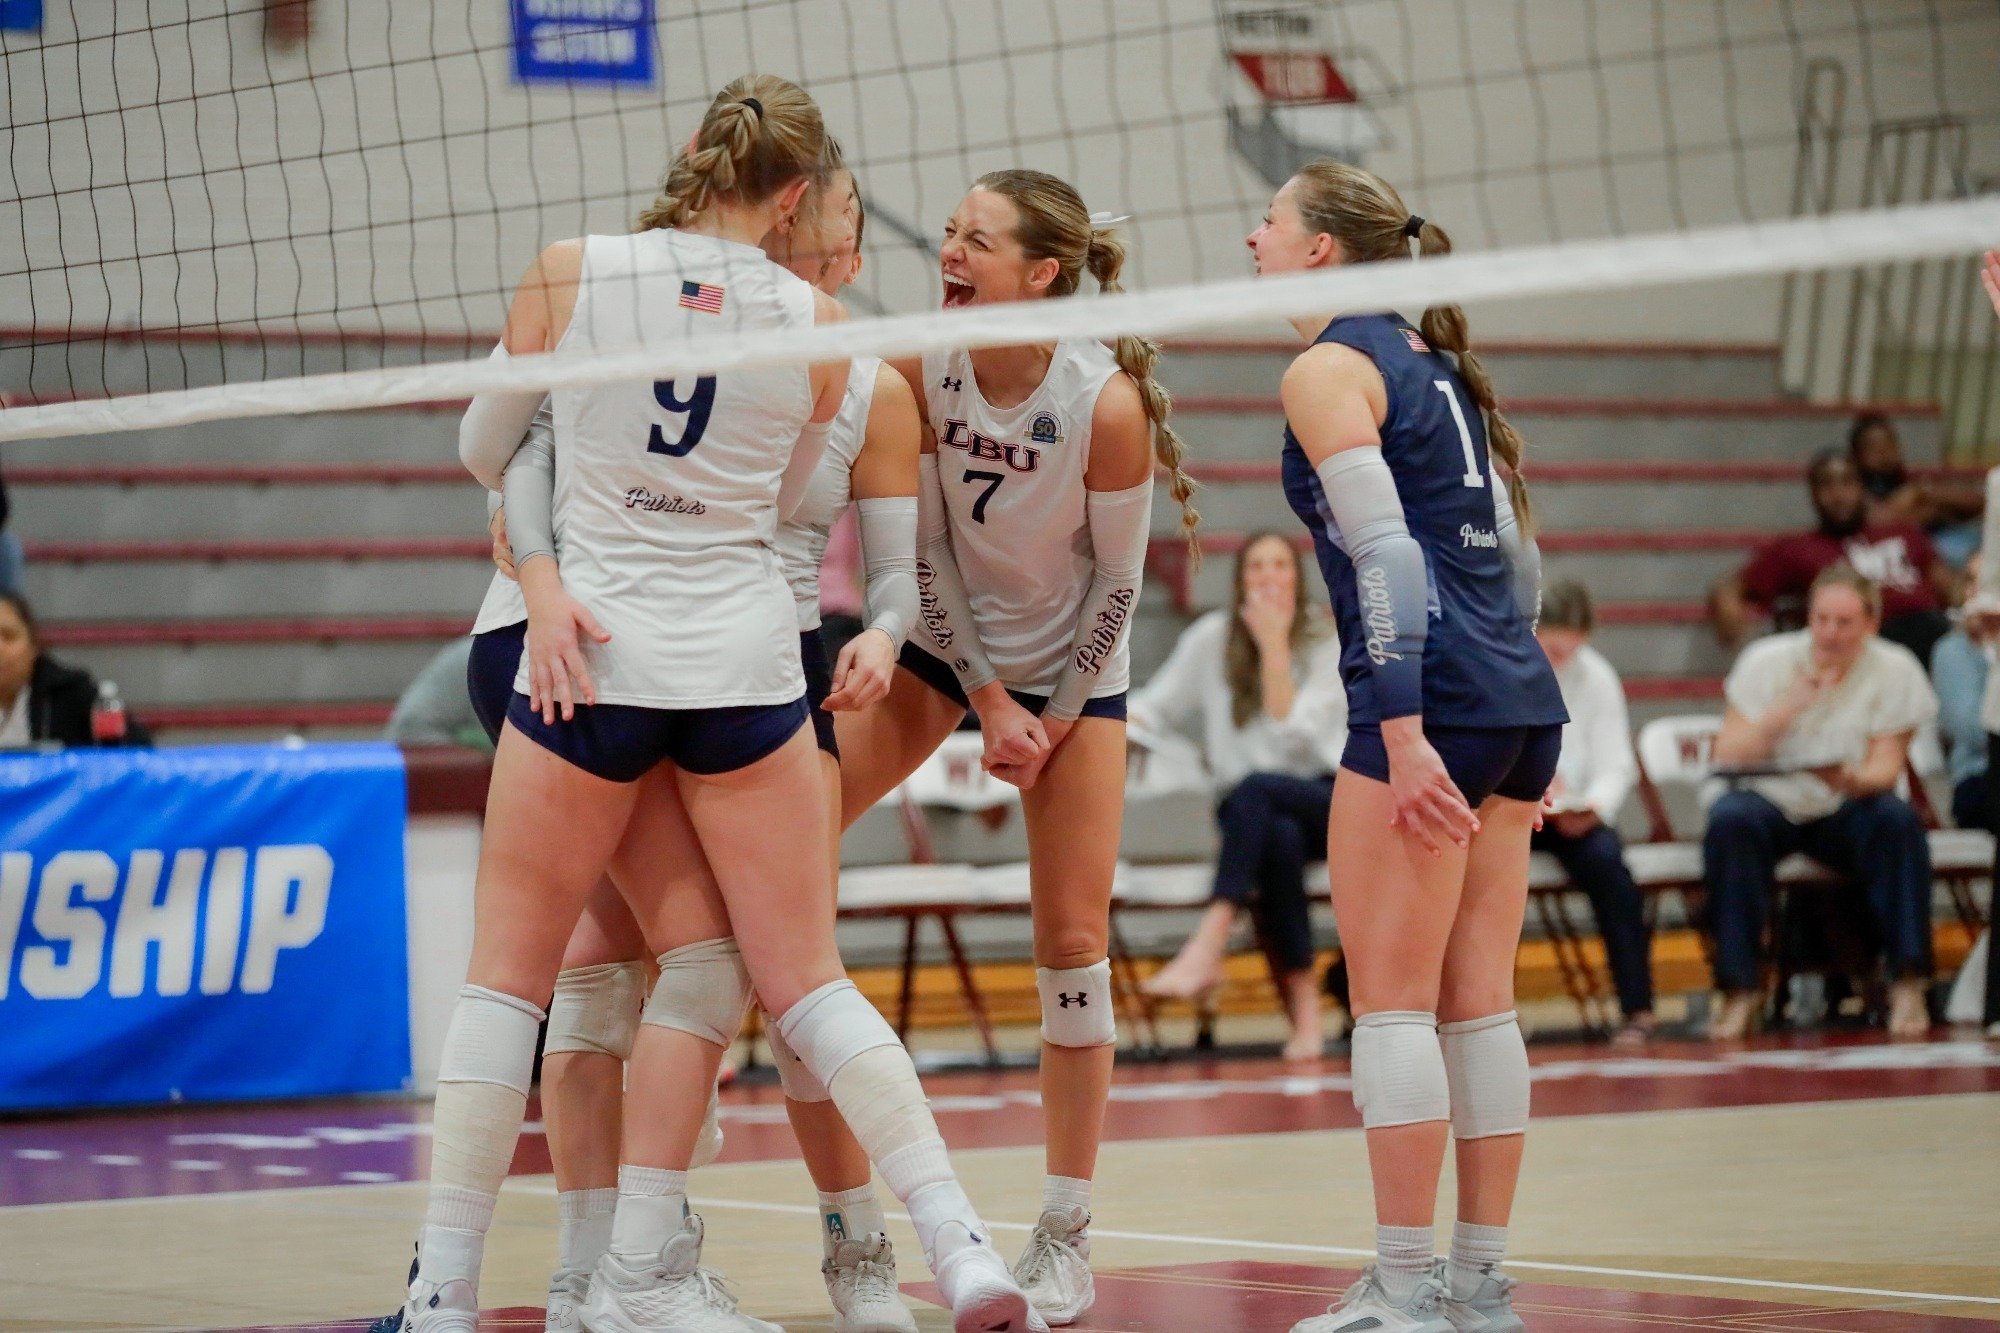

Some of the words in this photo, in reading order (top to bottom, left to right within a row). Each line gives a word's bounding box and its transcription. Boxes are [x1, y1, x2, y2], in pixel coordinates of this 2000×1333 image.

[647, 372, 717, 458] 9
[1433, 380, 1485, 488] 1
[623, 486, 706, 515] Patriots
[962, 469, 1006, 525] 7
[1459, 522, 1499, 549] Patriots
[1073, 588, 1134, 676] Patriots
[1362, 565, 1405, 666] Patriots
